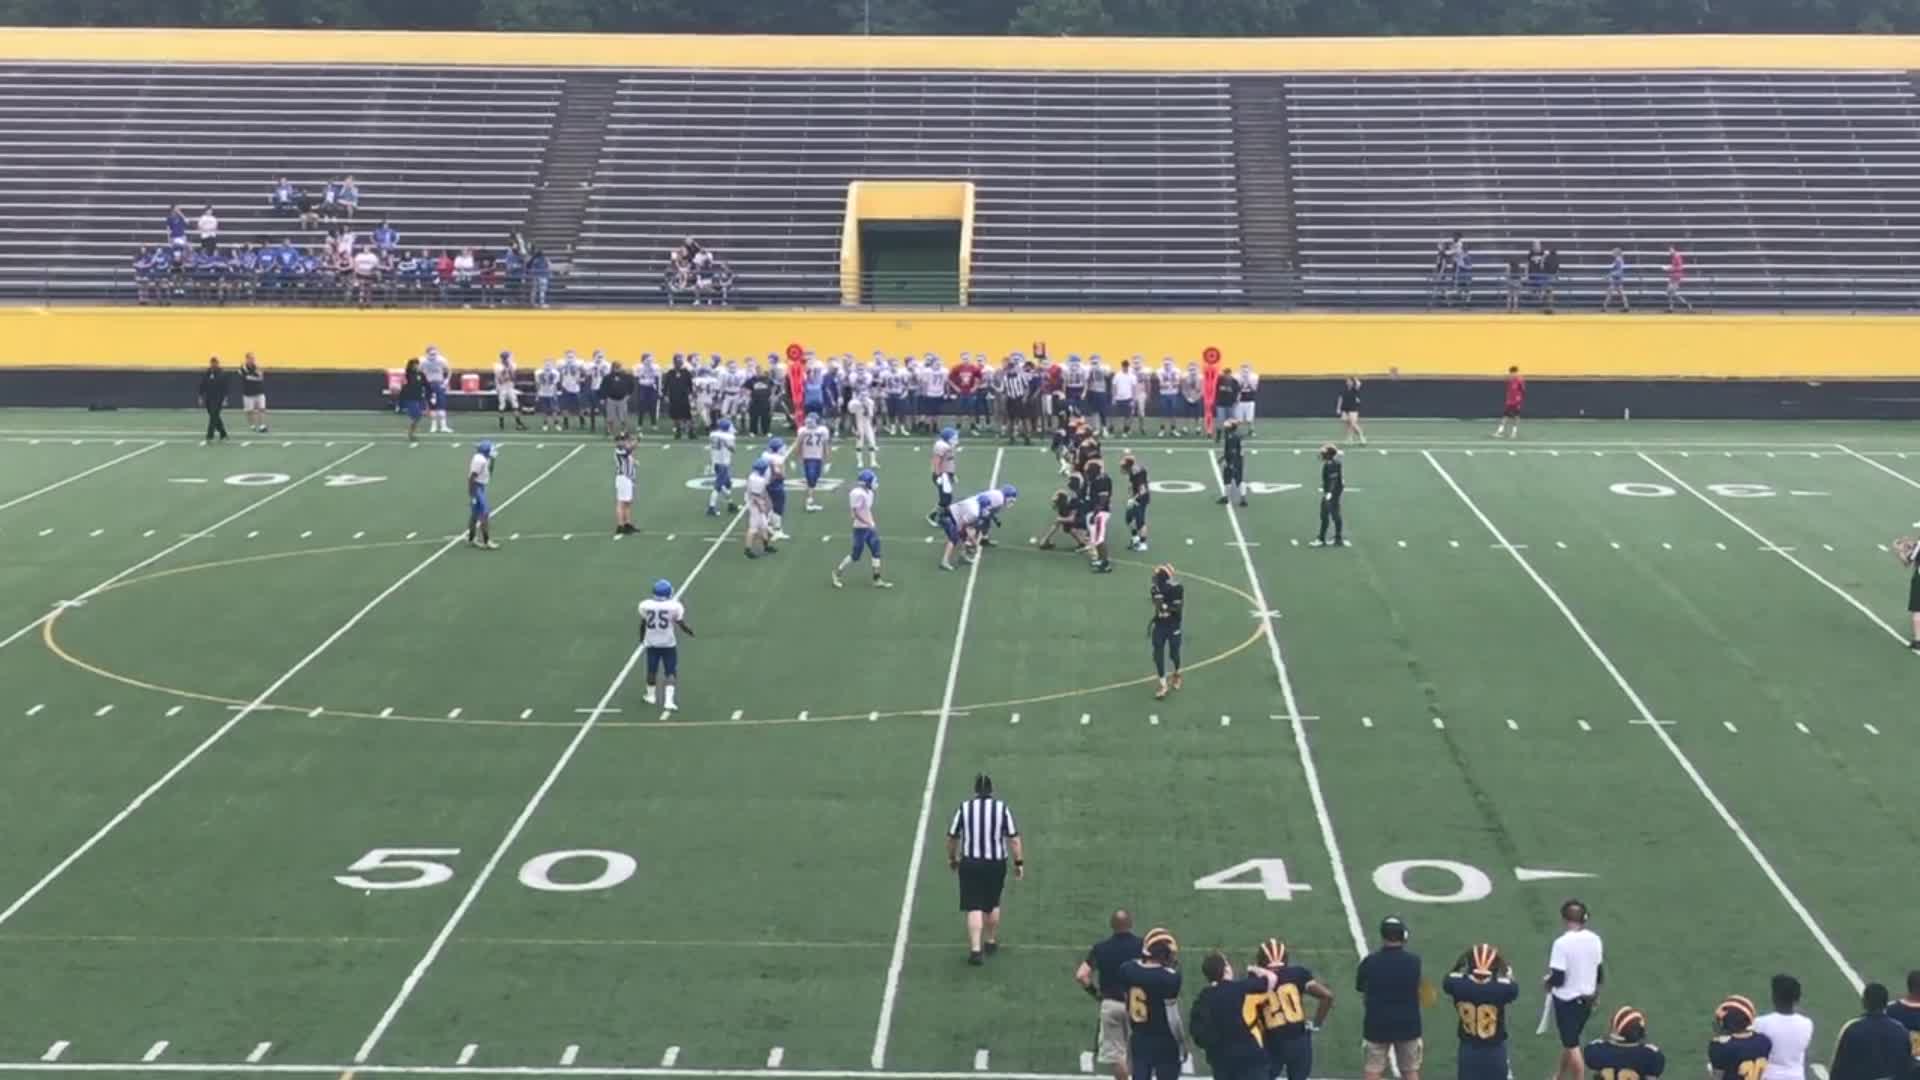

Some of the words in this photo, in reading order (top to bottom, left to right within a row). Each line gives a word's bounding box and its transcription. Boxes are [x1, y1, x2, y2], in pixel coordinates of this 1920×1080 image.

[804, 434, 826, 448] 27
[645, 610, 669, 629] 25
[334, 848, 638, 891] 50
[1194, 857, 1493, 903] 40
[1130, 986, 1148, 1023] 6
[1263, 983, 1305, 1028] 20
